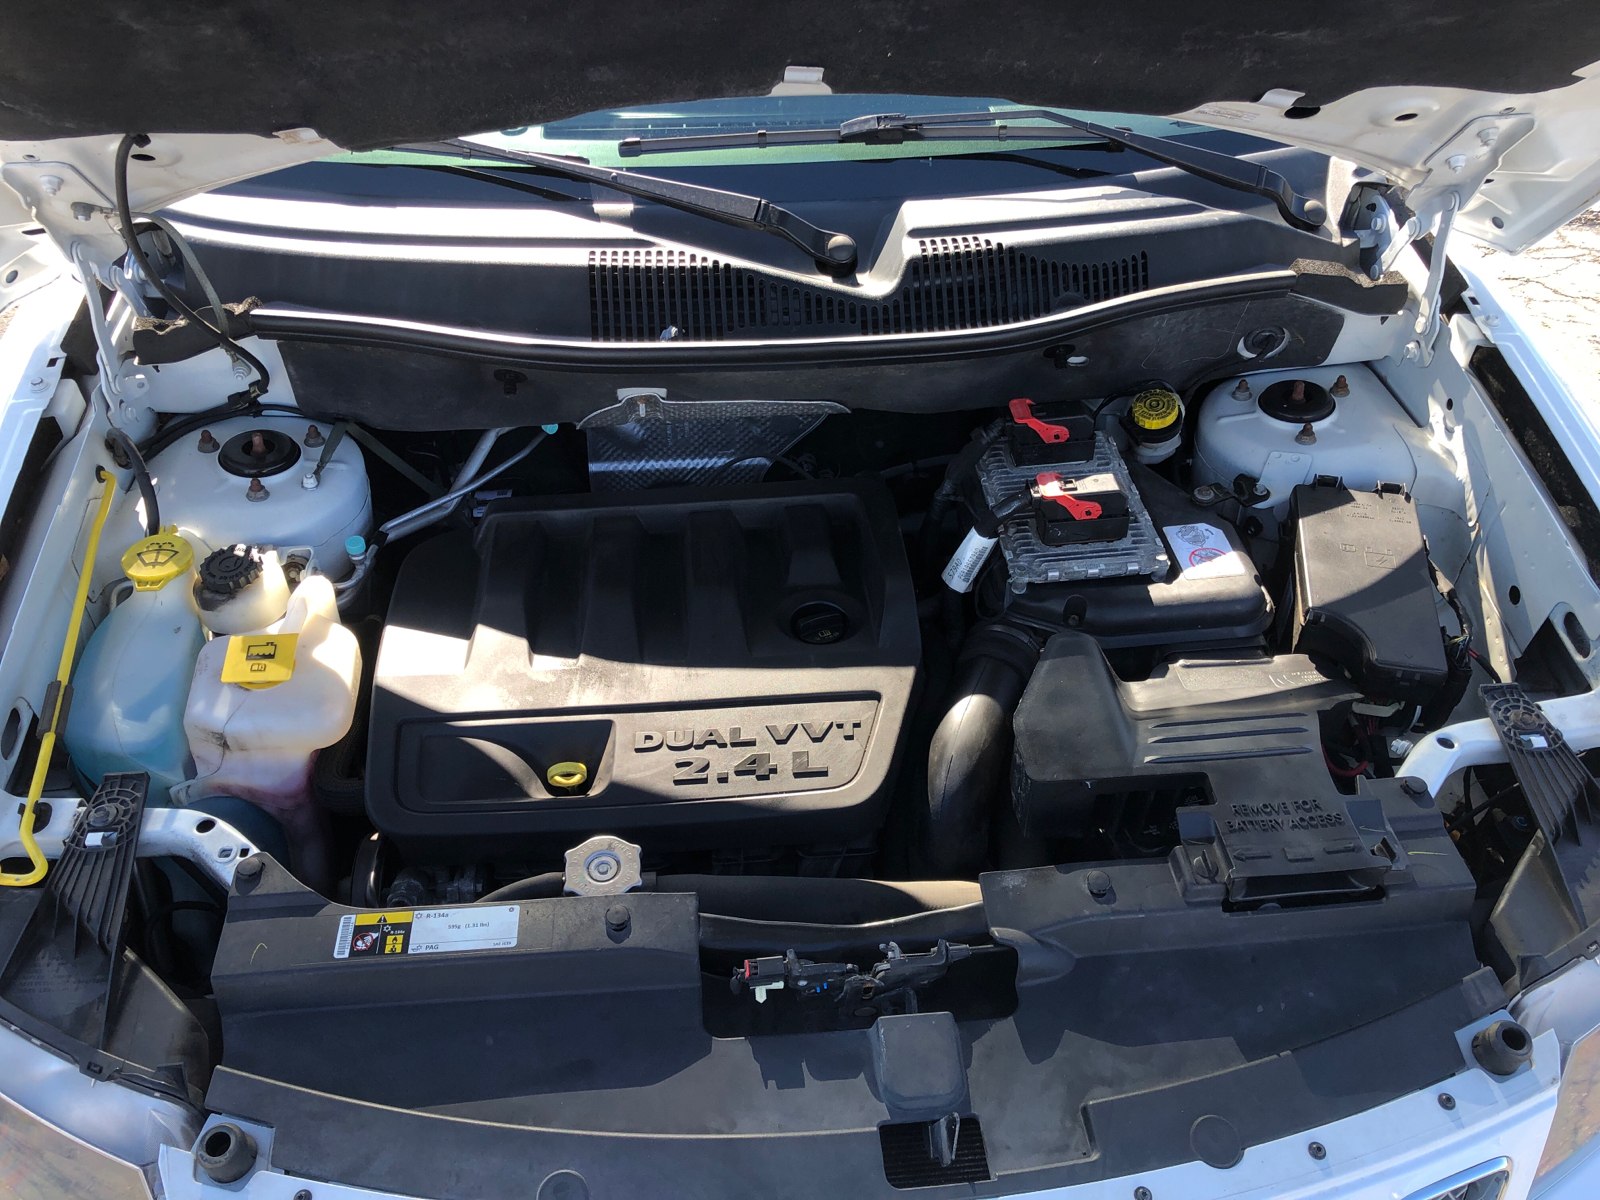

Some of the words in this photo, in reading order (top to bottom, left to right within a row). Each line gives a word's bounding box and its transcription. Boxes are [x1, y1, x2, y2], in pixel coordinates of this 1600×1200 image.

[634, 726, 757, 753] DUAL
[766, 719, 861, 744] VVT
[673, 750, 828, 786] 2.4L
[1230, 802, 1290, 817] REMOVE
[1292, 799, 1322, 813] FOR
[1225, 818, 1284, 834] BATTERY
[1290, 812, 1345, 831] ACCESS
